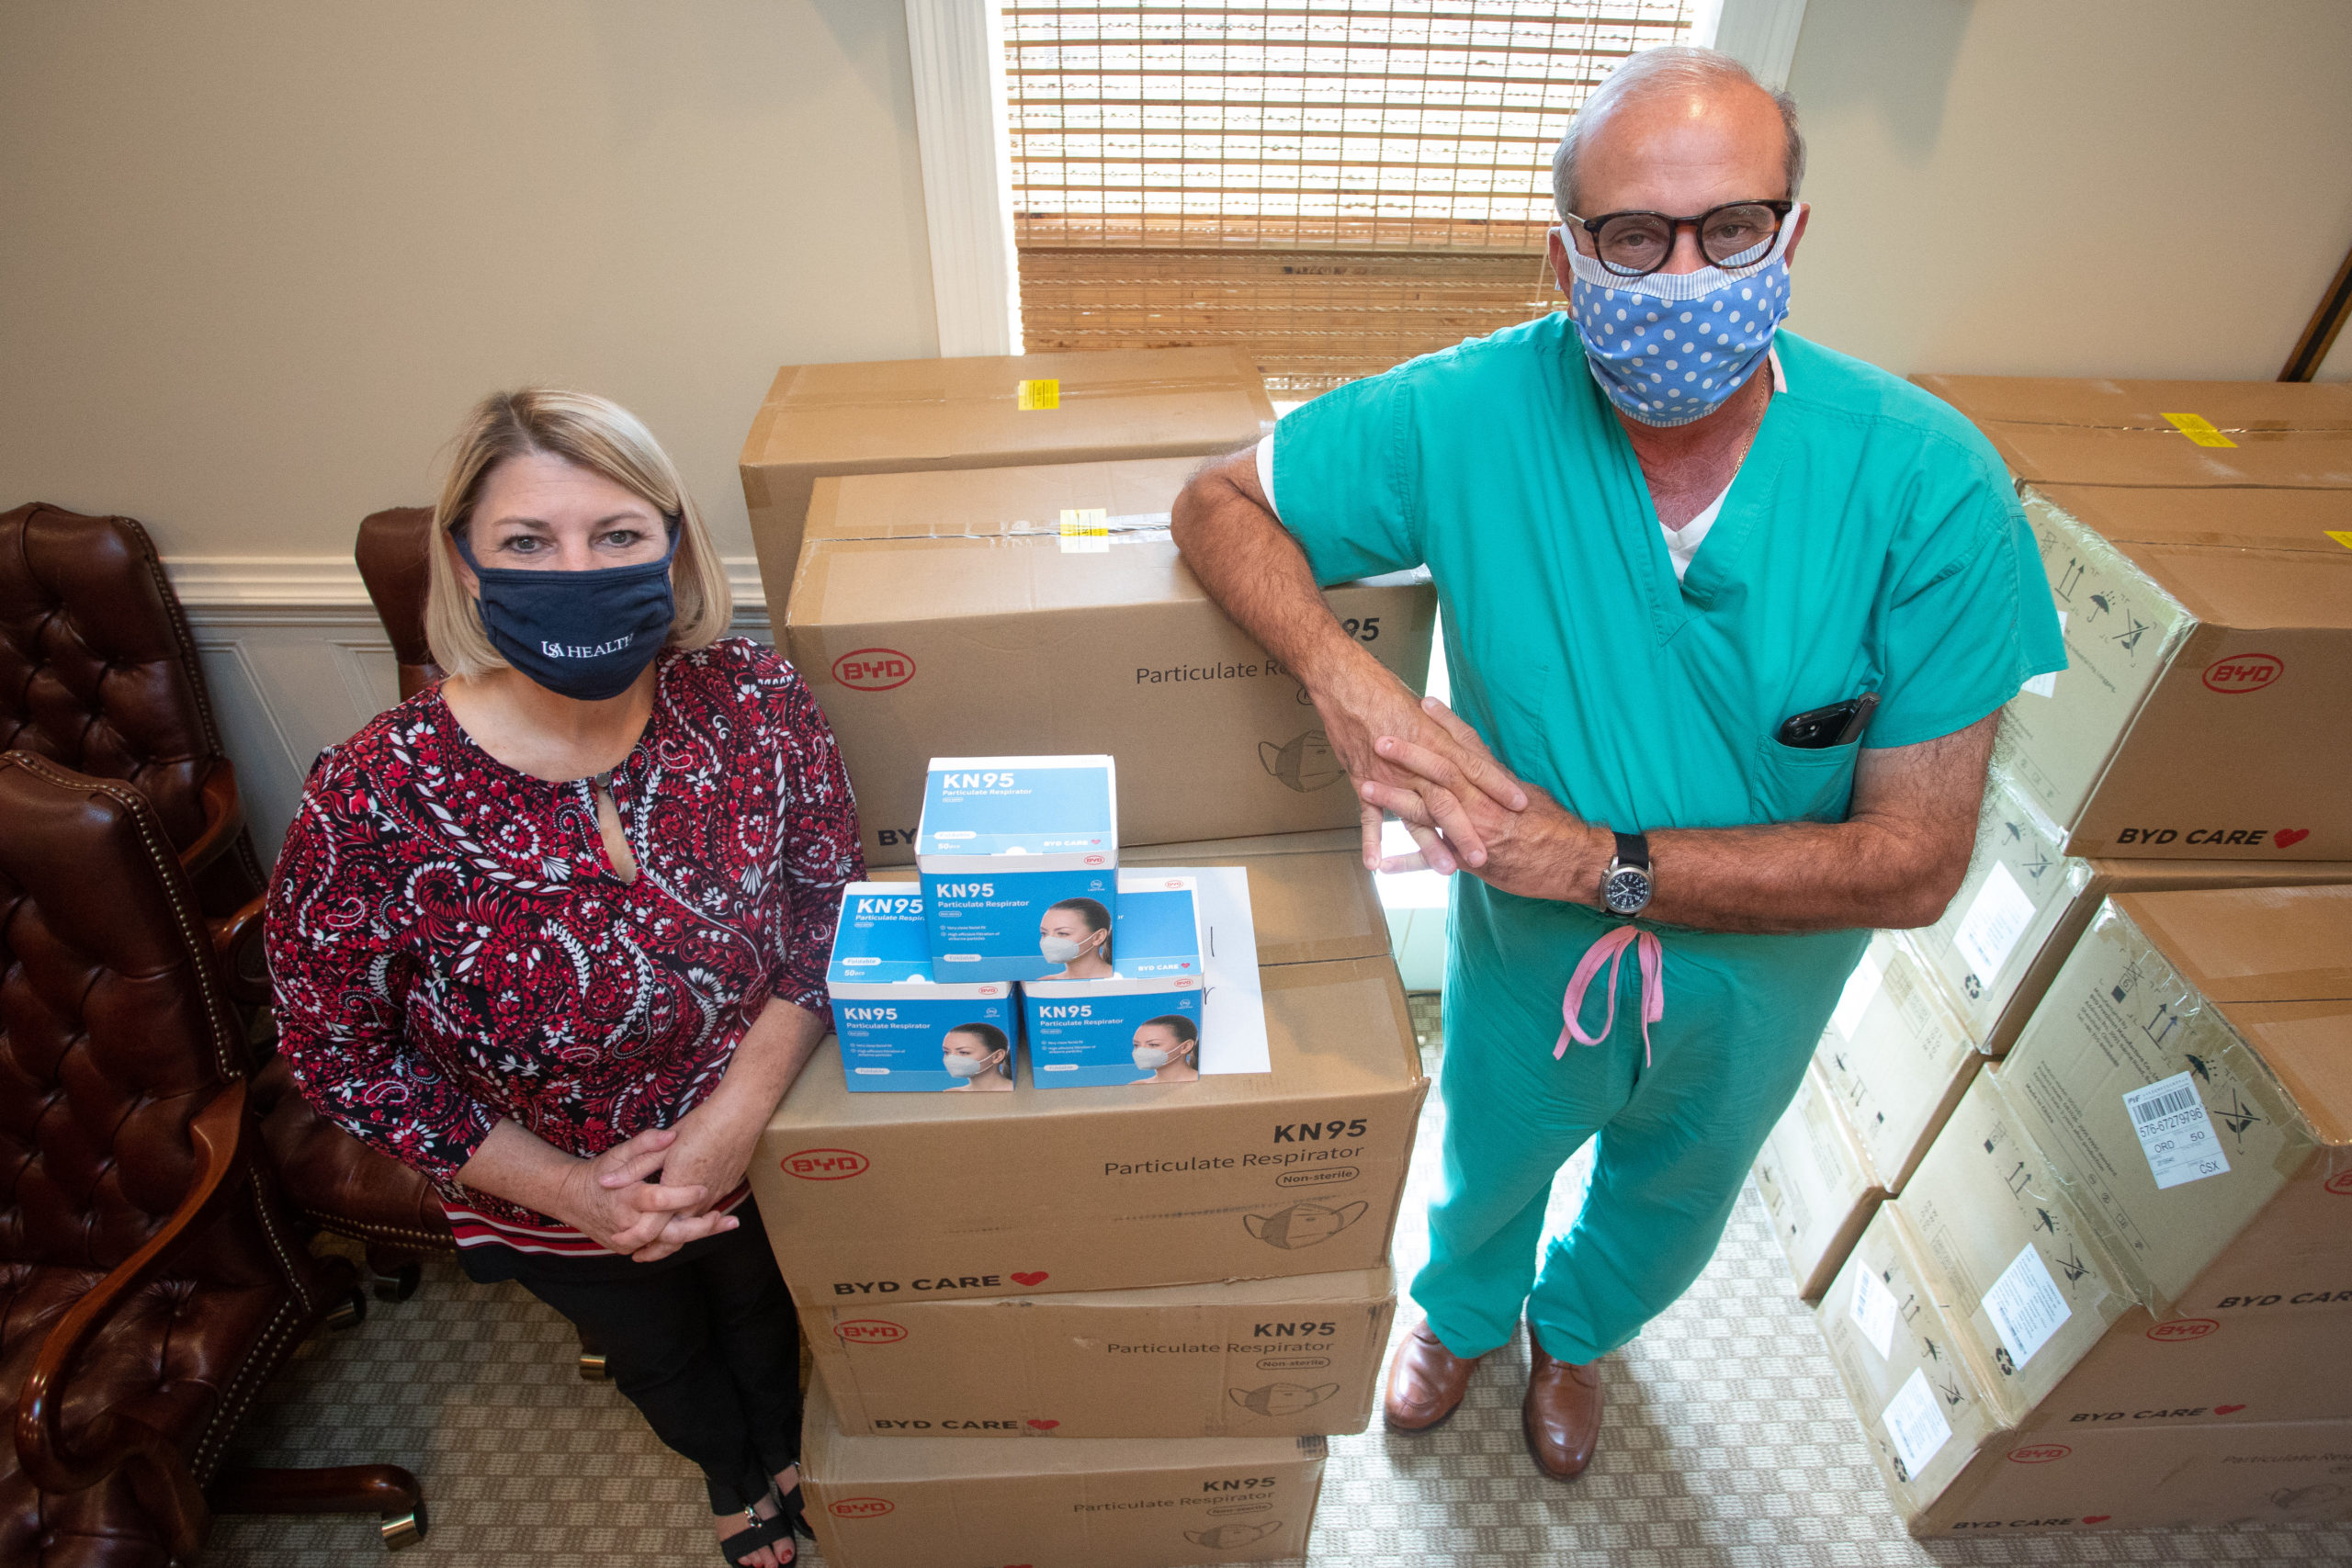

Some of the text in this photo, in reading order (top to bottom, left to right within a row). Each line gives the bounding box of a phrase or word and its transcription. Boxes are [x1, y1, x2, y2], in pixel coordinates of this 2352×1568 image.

[1341, 617, 1380, 641] 95
[842, 660, 905, 681] BYD
[1136, 661, 1258, 684] Particulate
[2211, 665, 2275, 682] BYD
[943, 773, 1014, 789] KN95
[942, 787, 1033, 796] Particulate Respirator
[877, 828, 918, 846] BY
[2116, 828, 2268, 845] BYD CARE
[936, 883, 994, 898] KN95
[857, 898, 923, 914] KN95
[937, 899, 1029, 908] Particulate Respirator
[843, 1007, 898, 1021] KN95
[1039, 1005, 1092, 1019] KN95
[1083, 1018, 1124, 1026] Respirator
[2139, 1107, 2203, 1138] 576-67279796
[1273, 1118, 1368, 1144] KN95
[2154, 1140, 2175, 1154] ORD
[791, 1156, 859, 1173] BYD
[1104, 1146, 1365, 1176] Particulate Respirator
[2199, 1160, 2221, 1174] CSX
[1283, 1169, 1353, 1184] Non-sterile
[832, 1275, 1001, 1295] BYD CARE
[2217, 1290, 2352, 1309] BYD CAR
[842, 1326, 899, 1337] BYD
[1253, 1322, 1336, 1337] KN95
[2157, 1325, 2211, 1336] BYD
[1107, 1341, 1334, 1355] Particulate Respirator
[1262, 1359, 1324, 1368] Non-sterile
[2070, 1407, 2209, 1422] BYD CARE
[875, 1419, 1019, 1429] BYD CARE
[2016, 1449, 2064, 1460] BYD
[2222, 1454, 2315, 1463] Particulate
[1203, 1476, 1276, 1493] KN95
[836, 1503, 885, 1514] BYD
[1073, 1491, 1275, 1513] Particulate Respirator
[1952, 1517, 2076, 1529] BYD CARE
